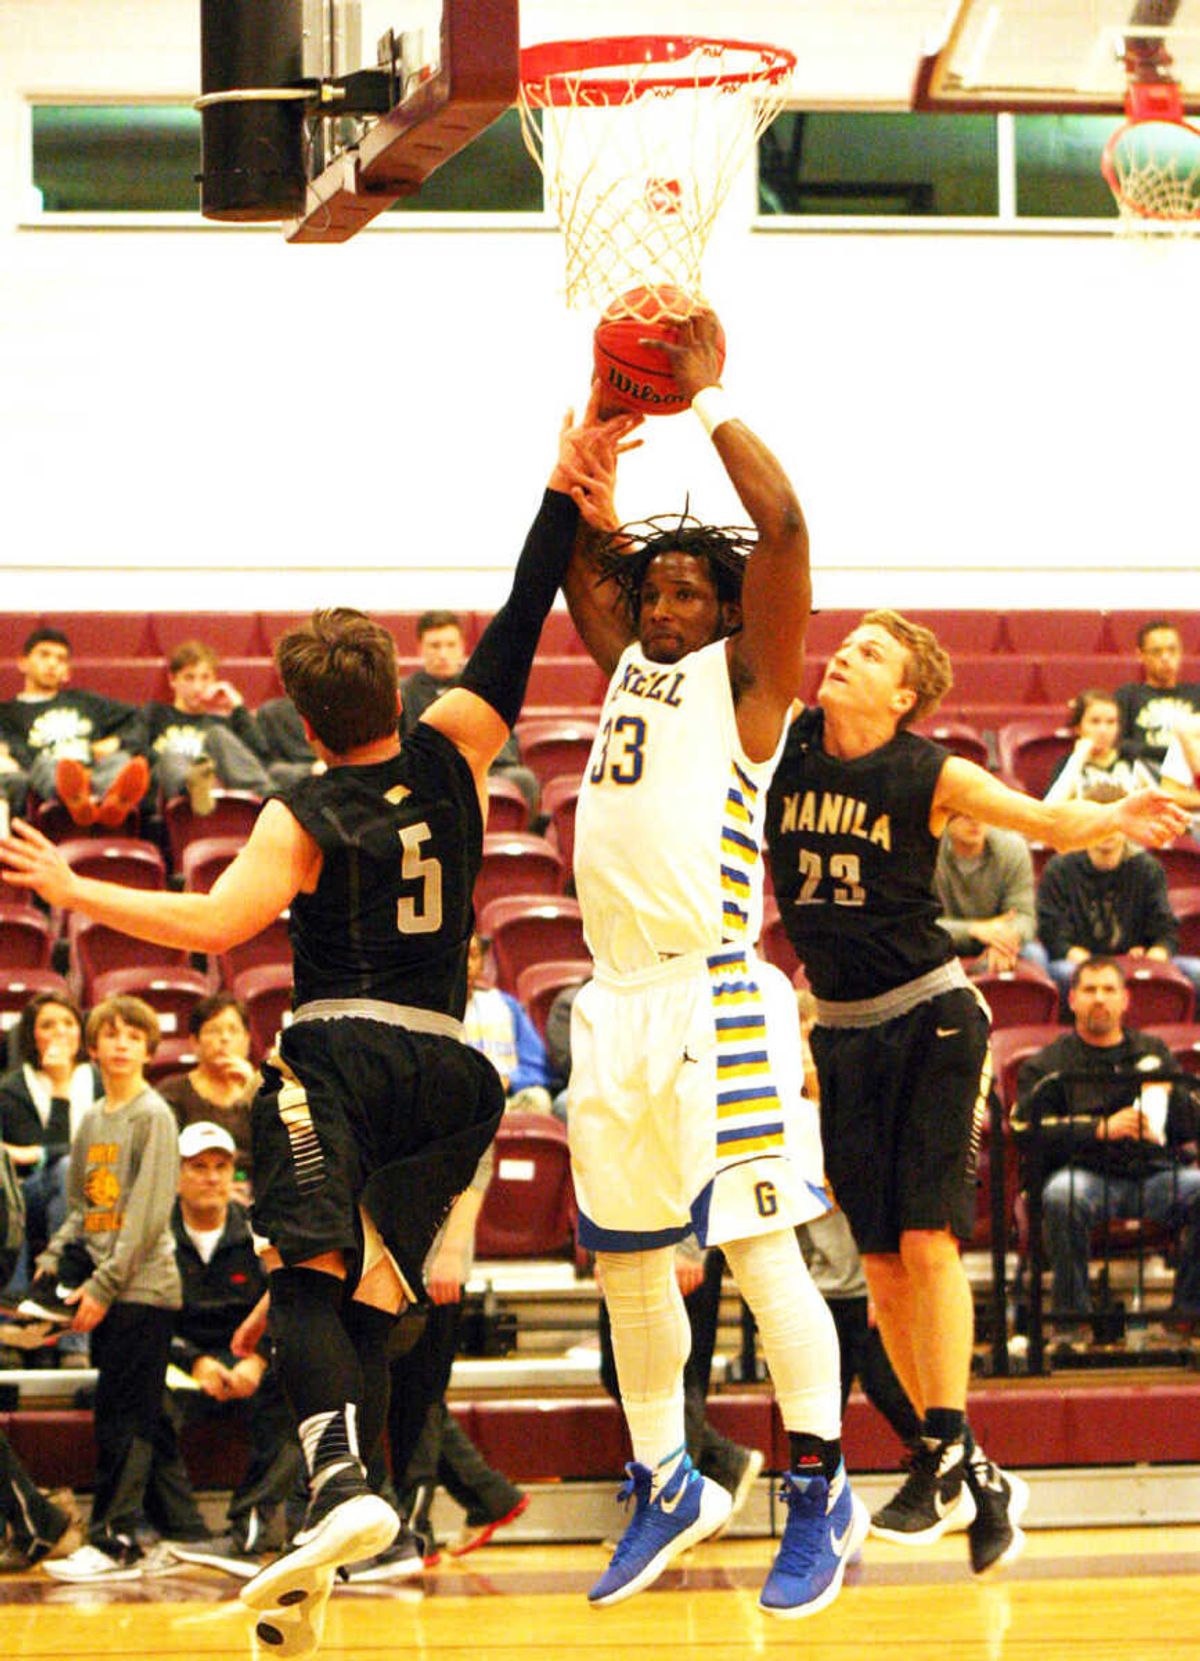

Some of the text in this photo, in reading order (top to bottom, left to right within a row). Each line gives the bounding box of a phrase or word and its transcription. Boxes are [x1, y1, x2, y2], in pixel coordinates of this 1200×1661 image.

[397, 821, 442, 934] 5
[794, 849, 867, 907] 23
[754, 1181, 777, 1217] G
